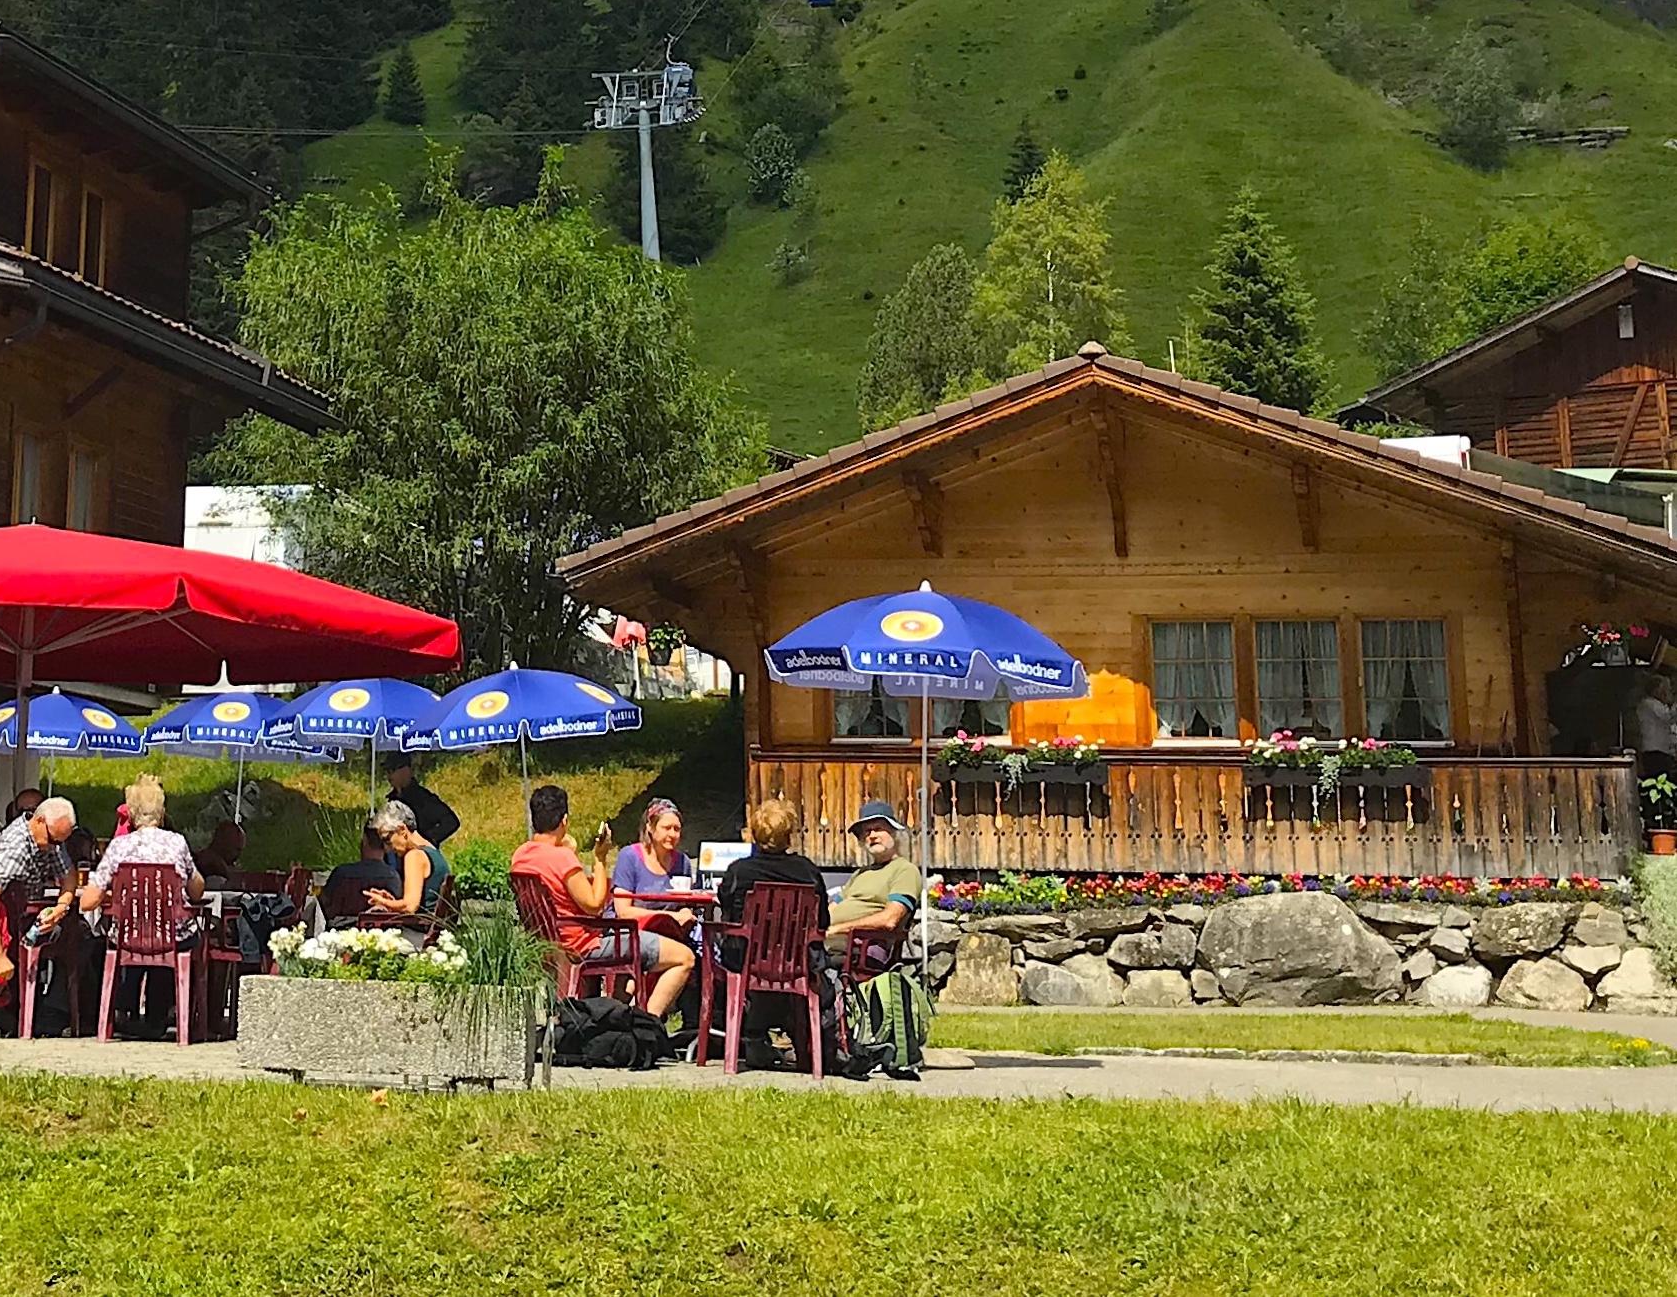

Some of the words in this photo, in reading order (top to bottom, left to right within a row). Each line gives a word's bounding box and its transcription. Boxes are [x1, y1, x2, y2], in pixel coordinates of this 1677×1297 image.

[860, 650, 959, 669] MINERAL
[309, 717, 371, 730] MINERAL
[539, 717, 598, 736] adelbodner
[26, 731, 71, 746] elbodner
[196, 726, 253, 740] MINERAL
[449, 723, 515, 740] MINERAL
[90, 734, 136, 746] MINERAL
